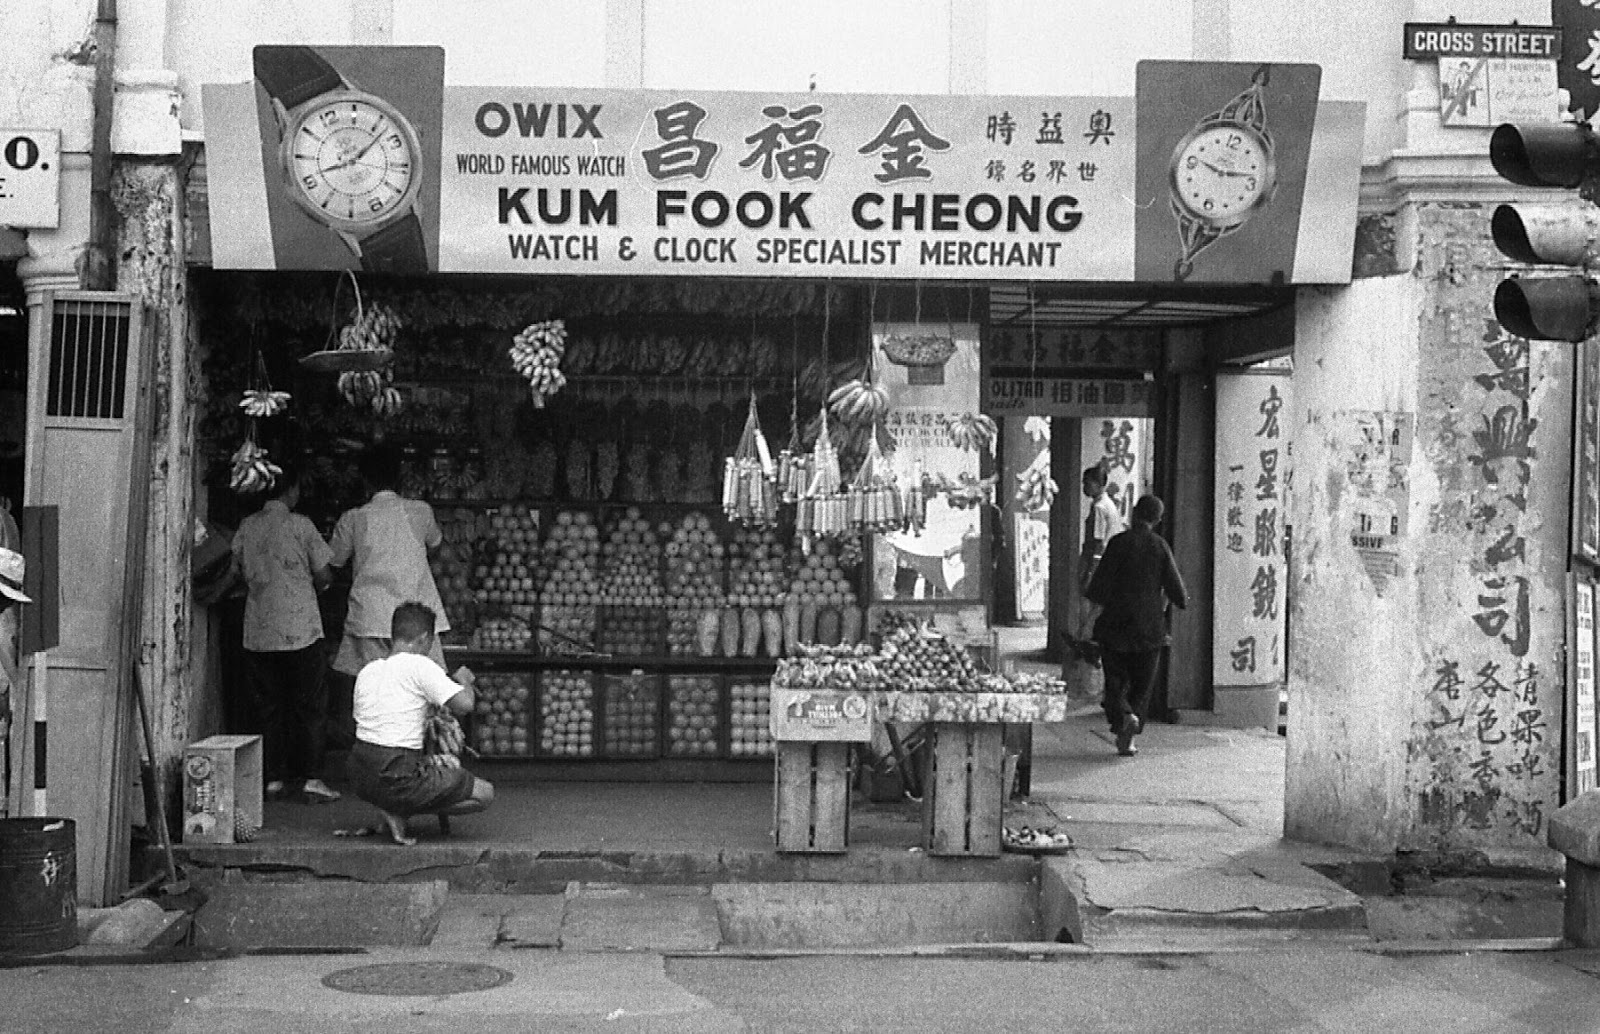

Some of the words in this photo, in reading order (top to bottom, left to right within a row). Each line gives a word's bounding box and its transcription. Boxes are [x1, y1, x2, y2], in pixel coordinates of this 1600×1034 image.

[1414, 31, 1475, 52] CROSS
[1482, 32, 1556, 54] STREET
[474, 102, 603, 139] OWIX
[456, 154, 505, 176] WORLD
[512, 154, 571, 177] FAMOUS
[577, 155, 626, 177] WATCH
[498, 187, 618, 227] KUM
[656, 190, 813, 229] FOOK
[851, 192, 1083, 233] CHEONG
[508, 234, 599, 261] WATCH
[618, 235, 637, 261] &
[653, 237, 738, 263] CLOCK
[756, 238, 902, 266] SPECIALIST
[919, 240, 1063, 267] MERCHANT
